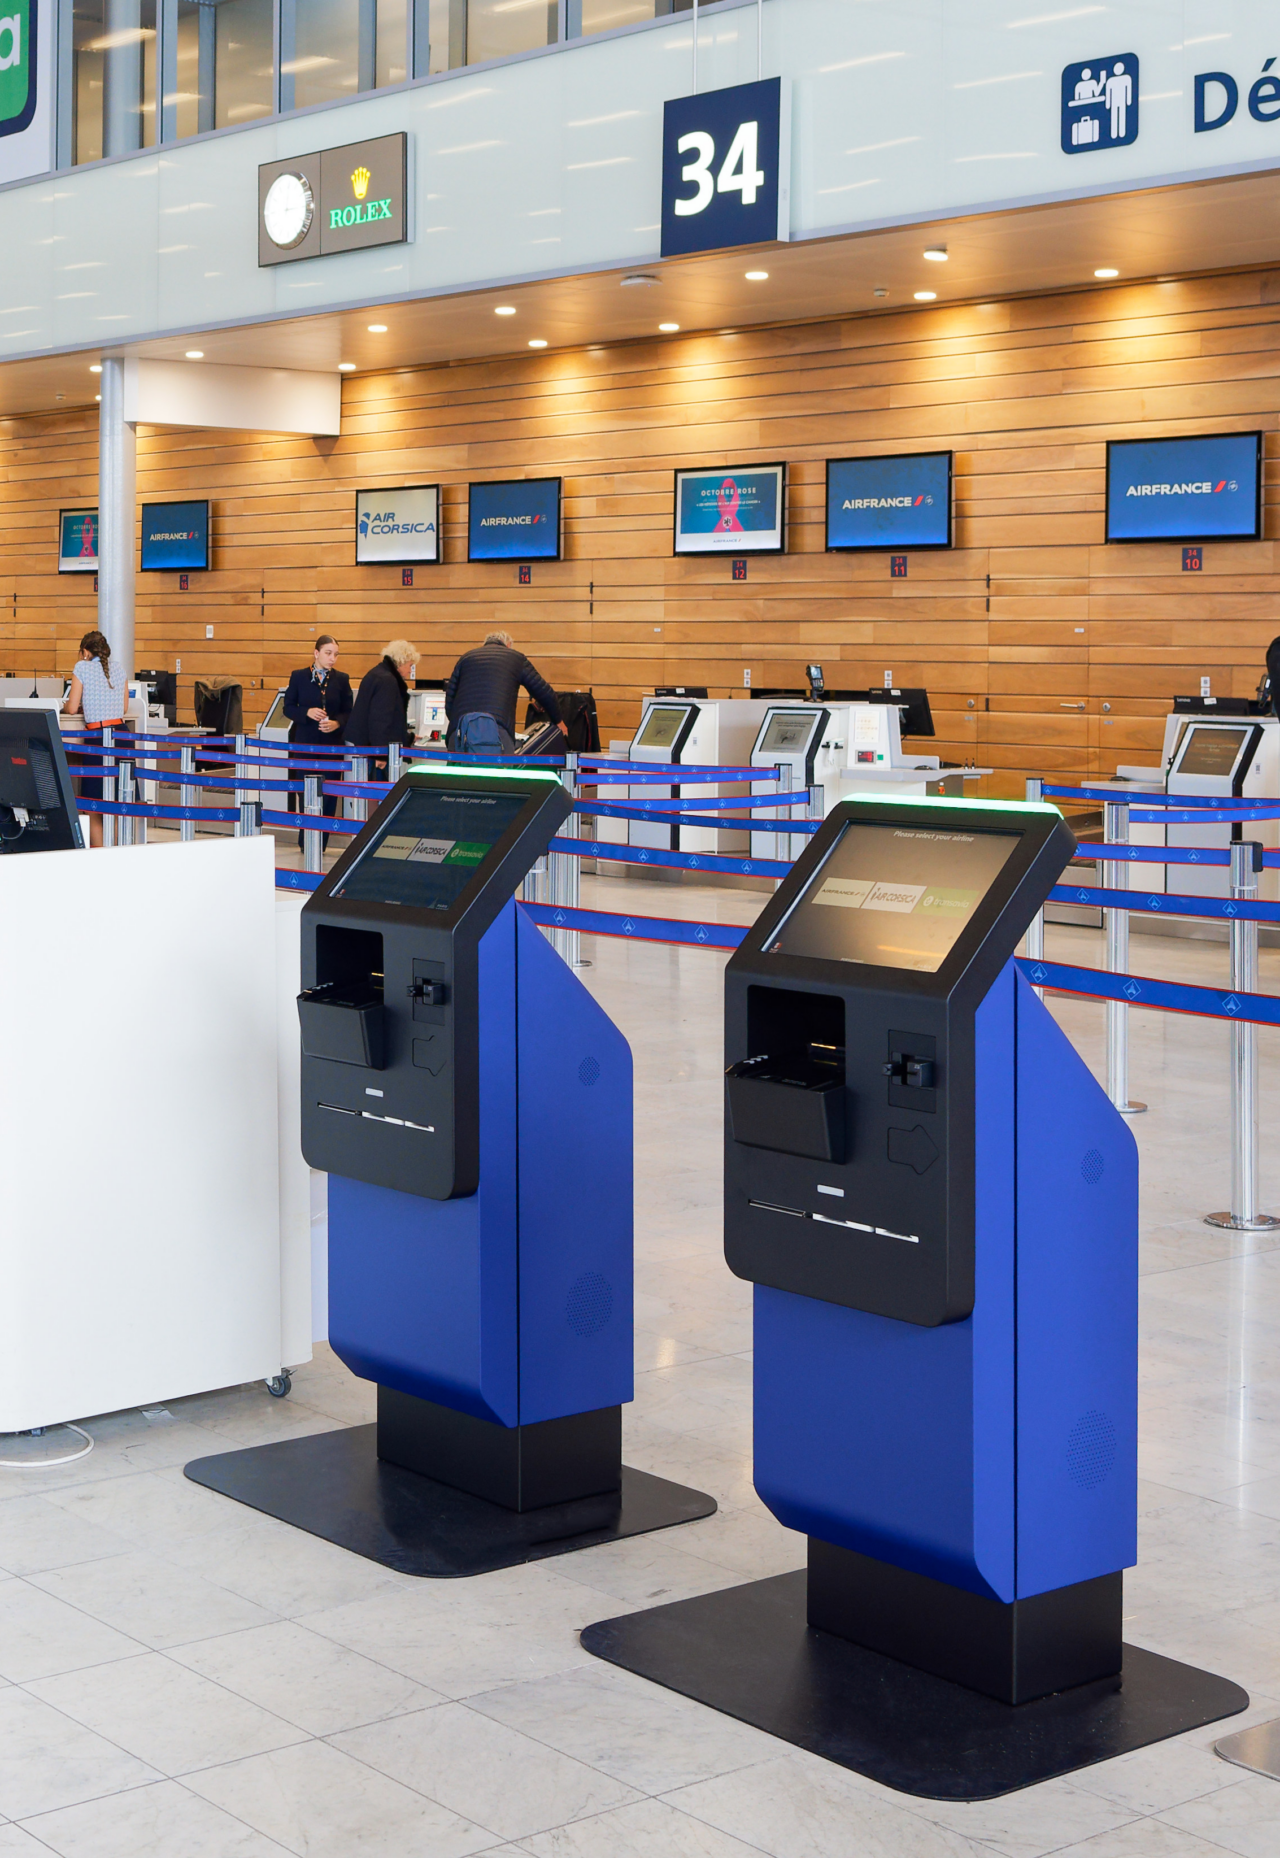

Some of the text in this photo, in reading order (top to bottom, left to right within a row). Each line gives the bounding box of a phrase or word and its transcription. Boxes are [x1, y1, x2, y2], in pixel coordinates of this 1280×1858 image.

[1194, 56, 1280, 133] Dé
[674, 120, 764, 216] 34
[329, 198, 392, 229] ROLEX
[701, 488, 734, 496] OCTOBRE
[1126, 482, 1212, 497] AIRFRANCE
[842, 497, 912, 510] AIRFRANCE
[371, 512, 395, 523] AIR
[480, 515, 531, 527] AIRFRANCE
[371, 522, 435, 535] CORSICA
[150, 532, 187, 541] AIRFRANCE
[1186, 558, 1200, 569] 10
[735, 569, 745, 578] 12
[894, 566, 905, 575] 11
[404, 577, 412, 585] 15
[521, 574, 529, 583] 14
[893, 830, 974, 843] Please select your airline
[821, 888, 855, 896] AIRFRANCE
[933, 898, 971, 909] transavia
